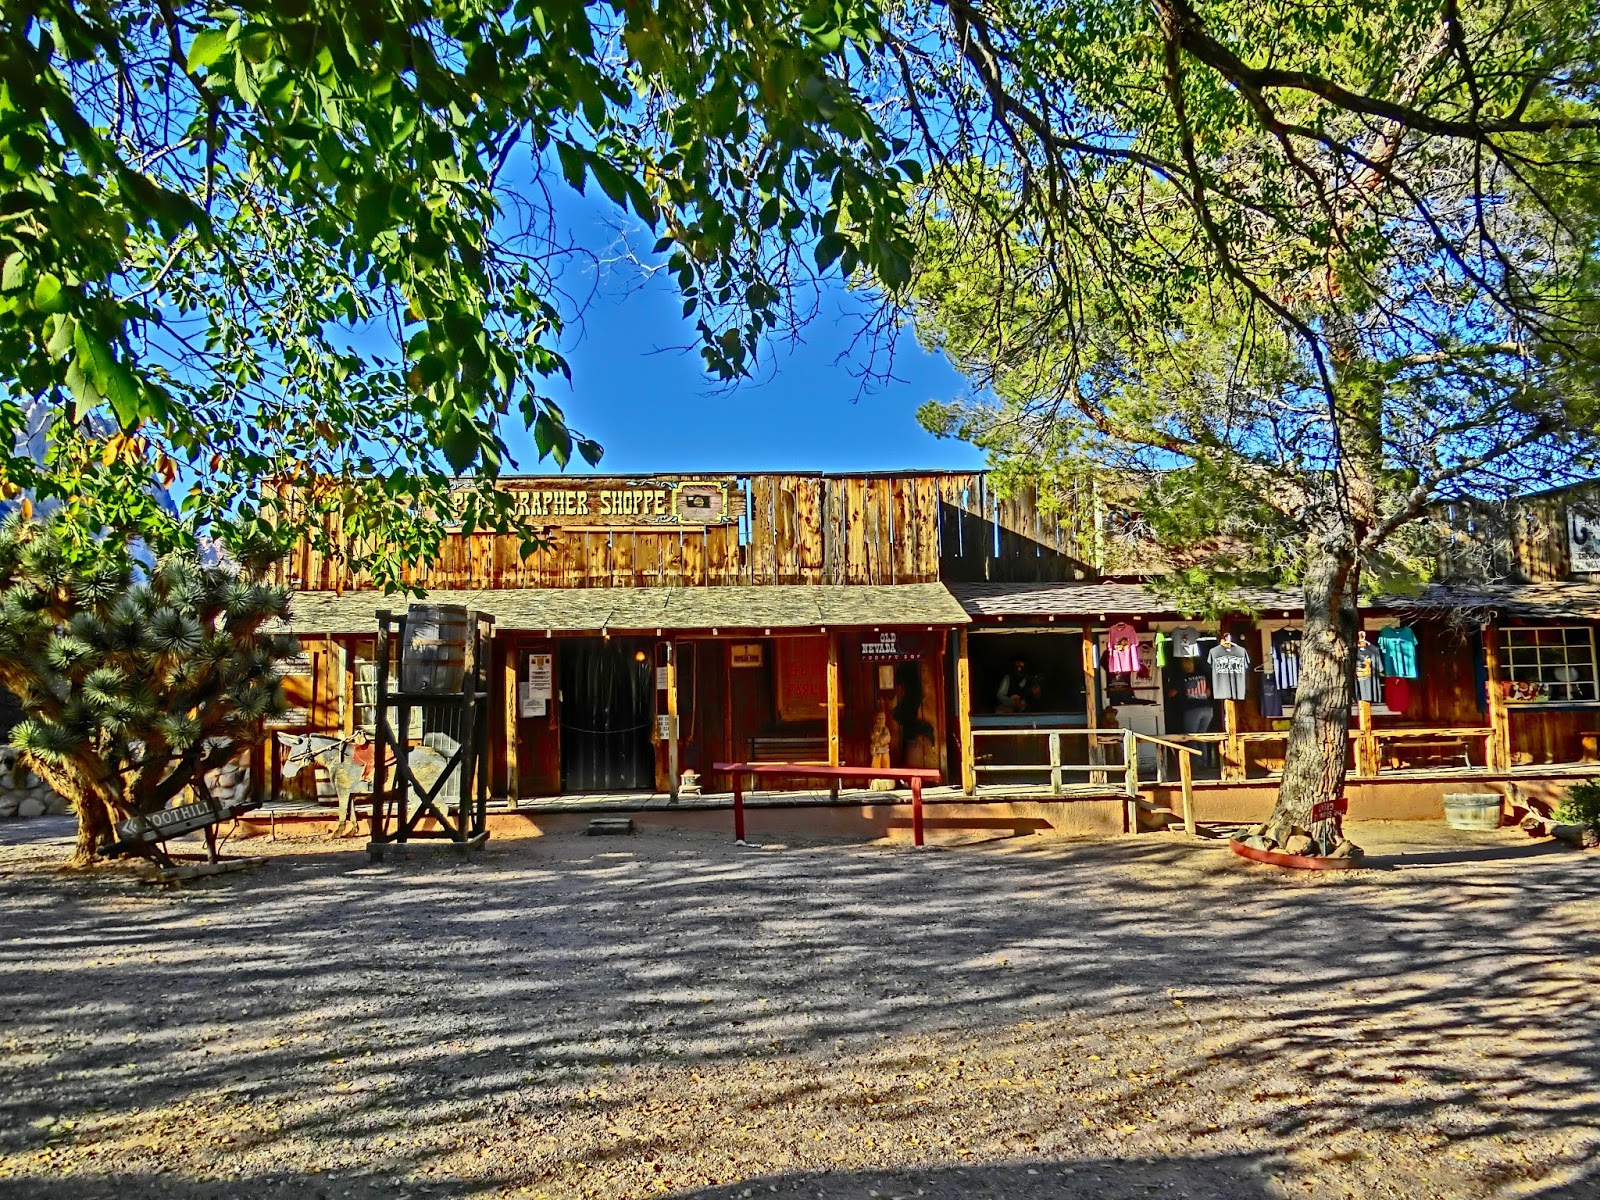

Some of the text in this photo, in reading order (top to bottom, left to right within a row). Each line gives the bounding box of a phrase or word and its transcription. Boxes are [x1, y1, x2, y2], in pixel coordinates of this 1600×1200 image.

[453, 490, 666, 517] POGRAPHER SHOPPE
[880, 632, 896, 643] OLD
[861, 643, 897, 654] NEVADA
